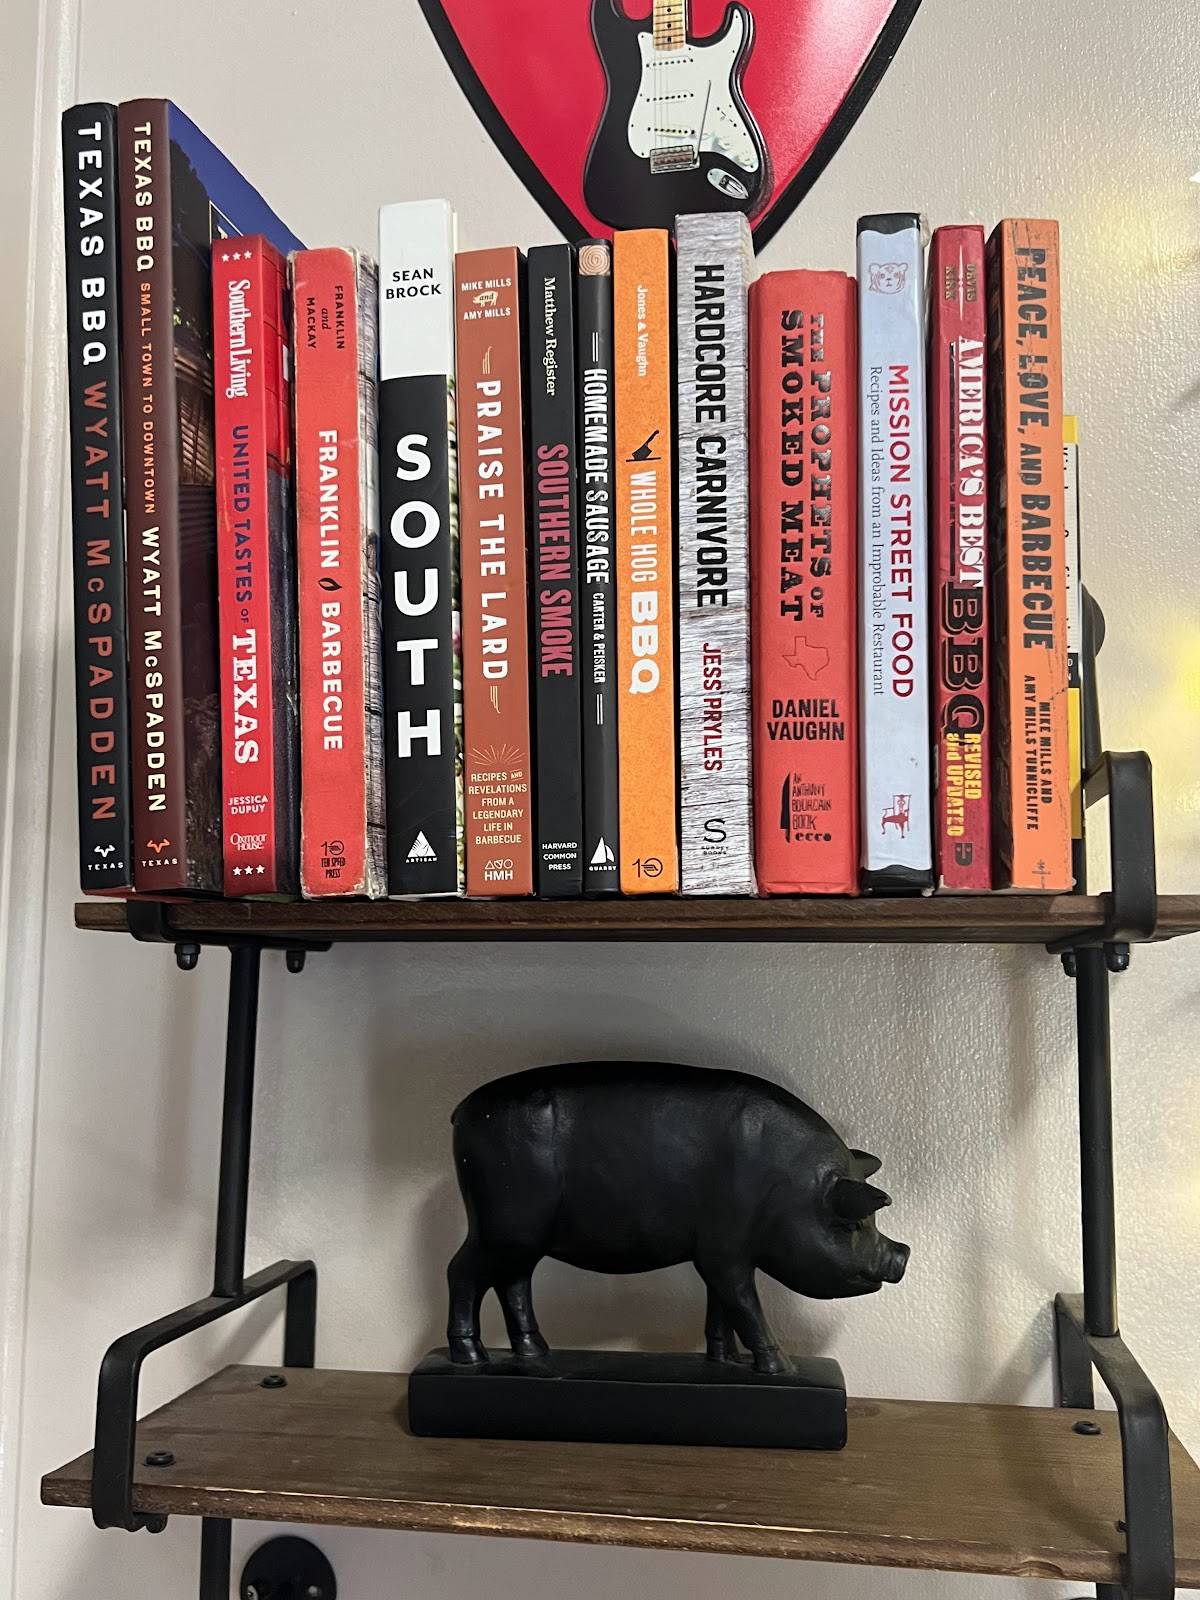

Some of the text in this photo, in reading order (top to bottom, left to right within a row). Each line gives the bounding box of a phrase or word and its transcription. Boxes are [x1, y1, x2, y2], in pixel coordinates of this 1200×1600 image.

[385, 284, 442, 300] BROCK
[392, 267, 434, 283] SEAN
[461, 278, 512, 292] MIKE MILLS
[479, 293, 494, 302] and
[225, 279, 253, 399] Southern Living
[307, 297, 317, 350] MACKAY
[321, 307, 332, 331] and
[334, 285, 345, 350] FRANKLIN
[463, 306, 511, 321] AMY MILLS
[541, 277, 558, 396] Matthew Register
[636, 284, 649, 378] Jones & Vaughn
[134, 121, 167, 812] TEXAS BBQ SMALL TOWN TO DOWNTOWN WYATT McSPADDEN
[694, 263, 729, 608] HARDCORE CARNIVORE
[780, 309, 804, 622] SMOKED MEAT
[810, 311, 833, 619] THE PROPHETS OF
[1014, 246, 1054, 650] PEACE, LOVE, AND BARBECUE
[78, 121, 116, 820] TEXAS BBQ WYATT McSPADDEN
[231, 424, 253, 624] UNITED TASTES OF
[476, 379, 509, 680] PRAISE THE LARD
[583, 368, 609, 684] HOMEMADE SAUSAGE CARTER & PEISKER
[867, 366, 885, 696] Recipes and Ideas from an Improbable Restaurant
[888, 364, 914, 699] MISSION STREET FOOD
[957, 502, 985, 588] BEST
[318, 429, 344, 751] FRANKLIN BARBECUE
[537, 444, 574, 678] SOUTHERN SMOKE
[628, 470, 660, 695] WHOLE HOG BBQ
[390, 434, 443, 758] SOUTH
[941, 580, 985, 742] BBQ
[231, 628, 260, 764] TEXAS
[703, 642, 724, 772] JESS PRYLES
[772, 698, 840, 719] DANIEL
[766, 721, 845, 741] VAUGHN
[1023, 674, 1039, 831] AMY MILLS TUNNICLIFFE
[1039, 701, 1053, 805] MIKE MILLS AND
[468, 783, 528, 795] REVELATIONS
[470, 771, 523, 783] RECIPES AND
[964, 733, 982, 800] REVISED
[228, 794, 269, 806] JESSICA
[231, 803, 266, 815] DUPUY
[472, 809, 524, 820] LEGENDARY
[481, 796, 515, 807] FROM A
[483, 822, 513, 832] LIFE IN
[946, 763, 965, 837] UPDATED
[87, 861, 124, 871] TEXAS
[142, 857, 178, 868] TEXAS
[230, 832, 268, 846] Oxmoor
[475, 834, 522, 845] BARBECUE
[542, 841, 578, 851] HARVARD
[543, 852, 577, 861] COMMON
[548, 862, 572, 871] PRESS
[325, 869, 341, 879] PRESS
[484, 870, 514, 881] HMH
